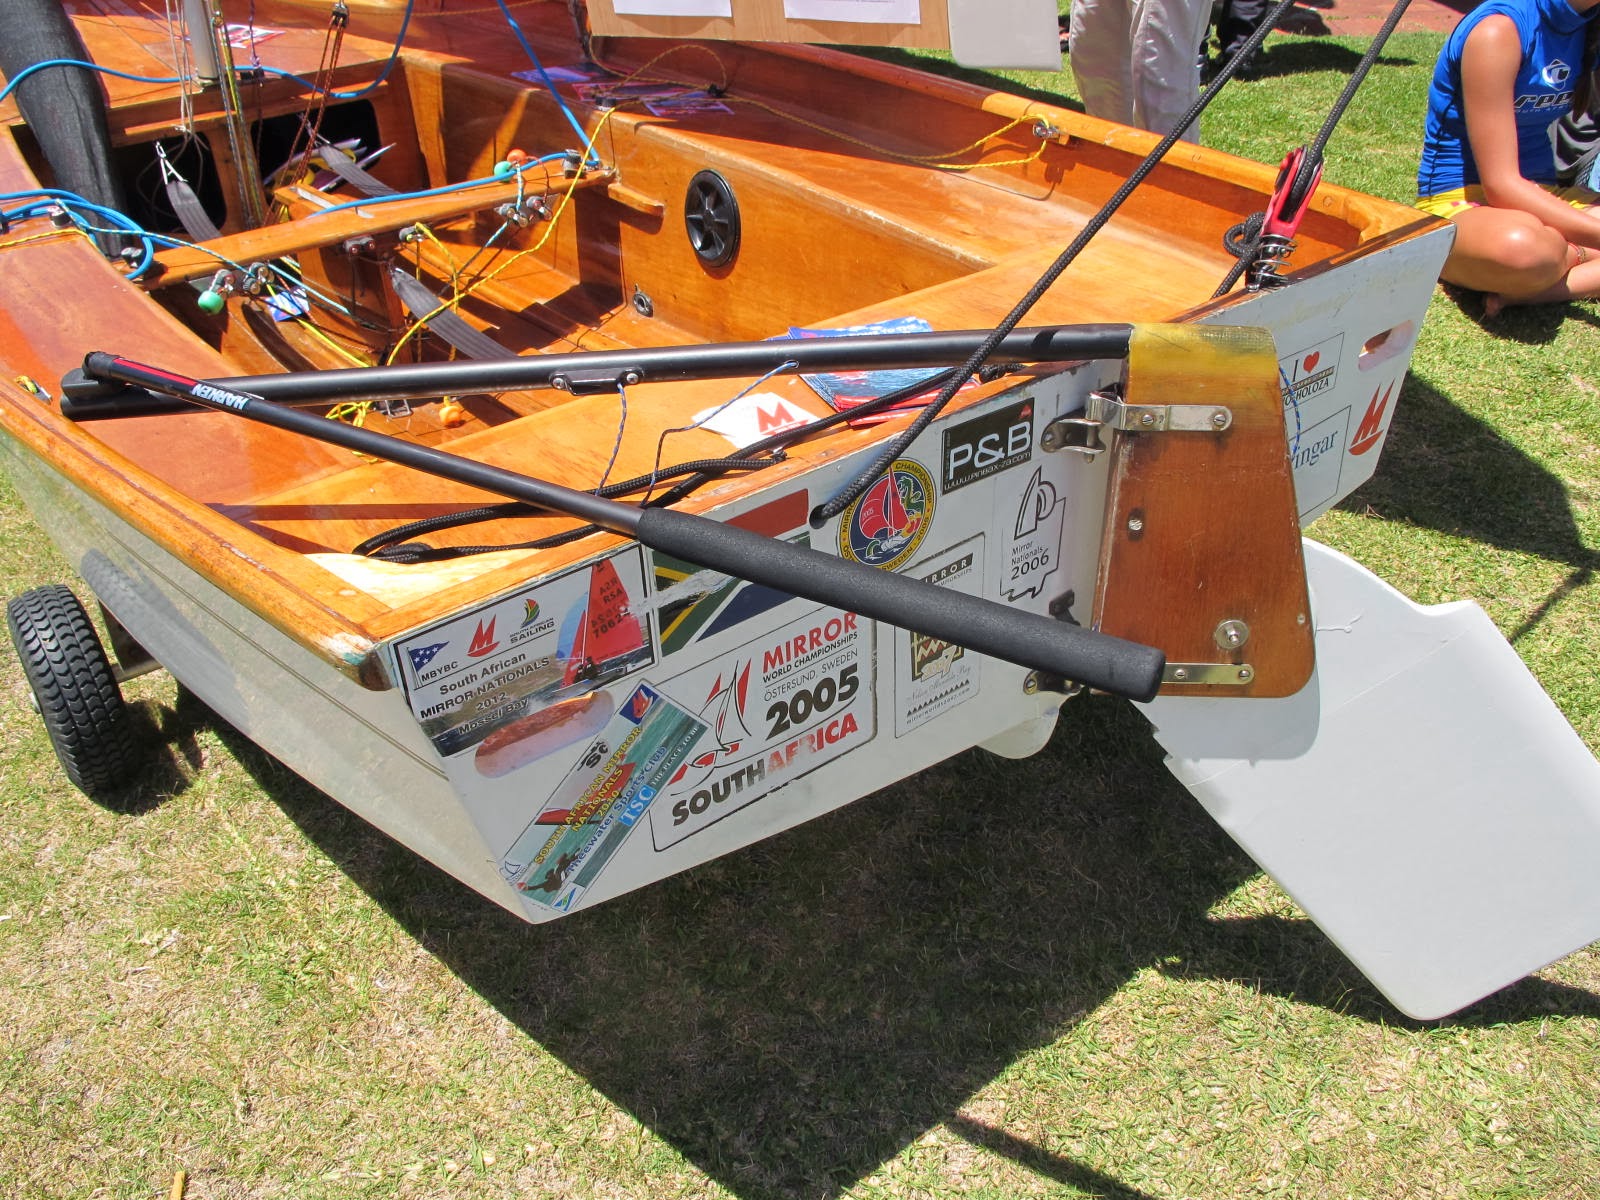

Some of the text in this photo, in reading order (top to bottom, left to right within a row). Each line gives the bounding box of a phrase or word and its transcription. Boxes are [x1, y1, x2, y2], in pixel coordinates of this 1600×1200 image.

[191, 383, 250, 410] HARKEN
[1283, 378, 1329, 406] OHOLOZA
[949, 421, 1031, 481] P&B
[1011, 541, 1034, 556] Mirror
[1011, 547, 1043, 566] Nationals
[1011, 548, 1049, 581] 2006
[925, 559, 968, 584] IRROR
[510, 621, 555, 644] SAILING
[763, 611, 858, 674] MIRROR
[421, 660, 459, 682] MBYBC
[439, 652, 526, 696] South African
[763, 632, 858, 683] WORLD CHAMPIONSHIPS
[821, 648, 858, 673] SWEDEN
[420, 657, 550, 719] MIRROR NATIONALS
[476, 691, 507, 711] 2012
[766, 662, 860, 741] 2005
[458, 698, 530, 735] Mossel Bay
[534, 825, 565, 865] SOUTH
[565, 776, 605, 824] AFRICAN
[603, 726, 643, 774] MIRROR
[572, 768, 623, 832] NATIONALS
[597, 790, 621, 817] 2010
[620, 786, 656, 826] TSC
[565, 812, 615, 875] Theewater
